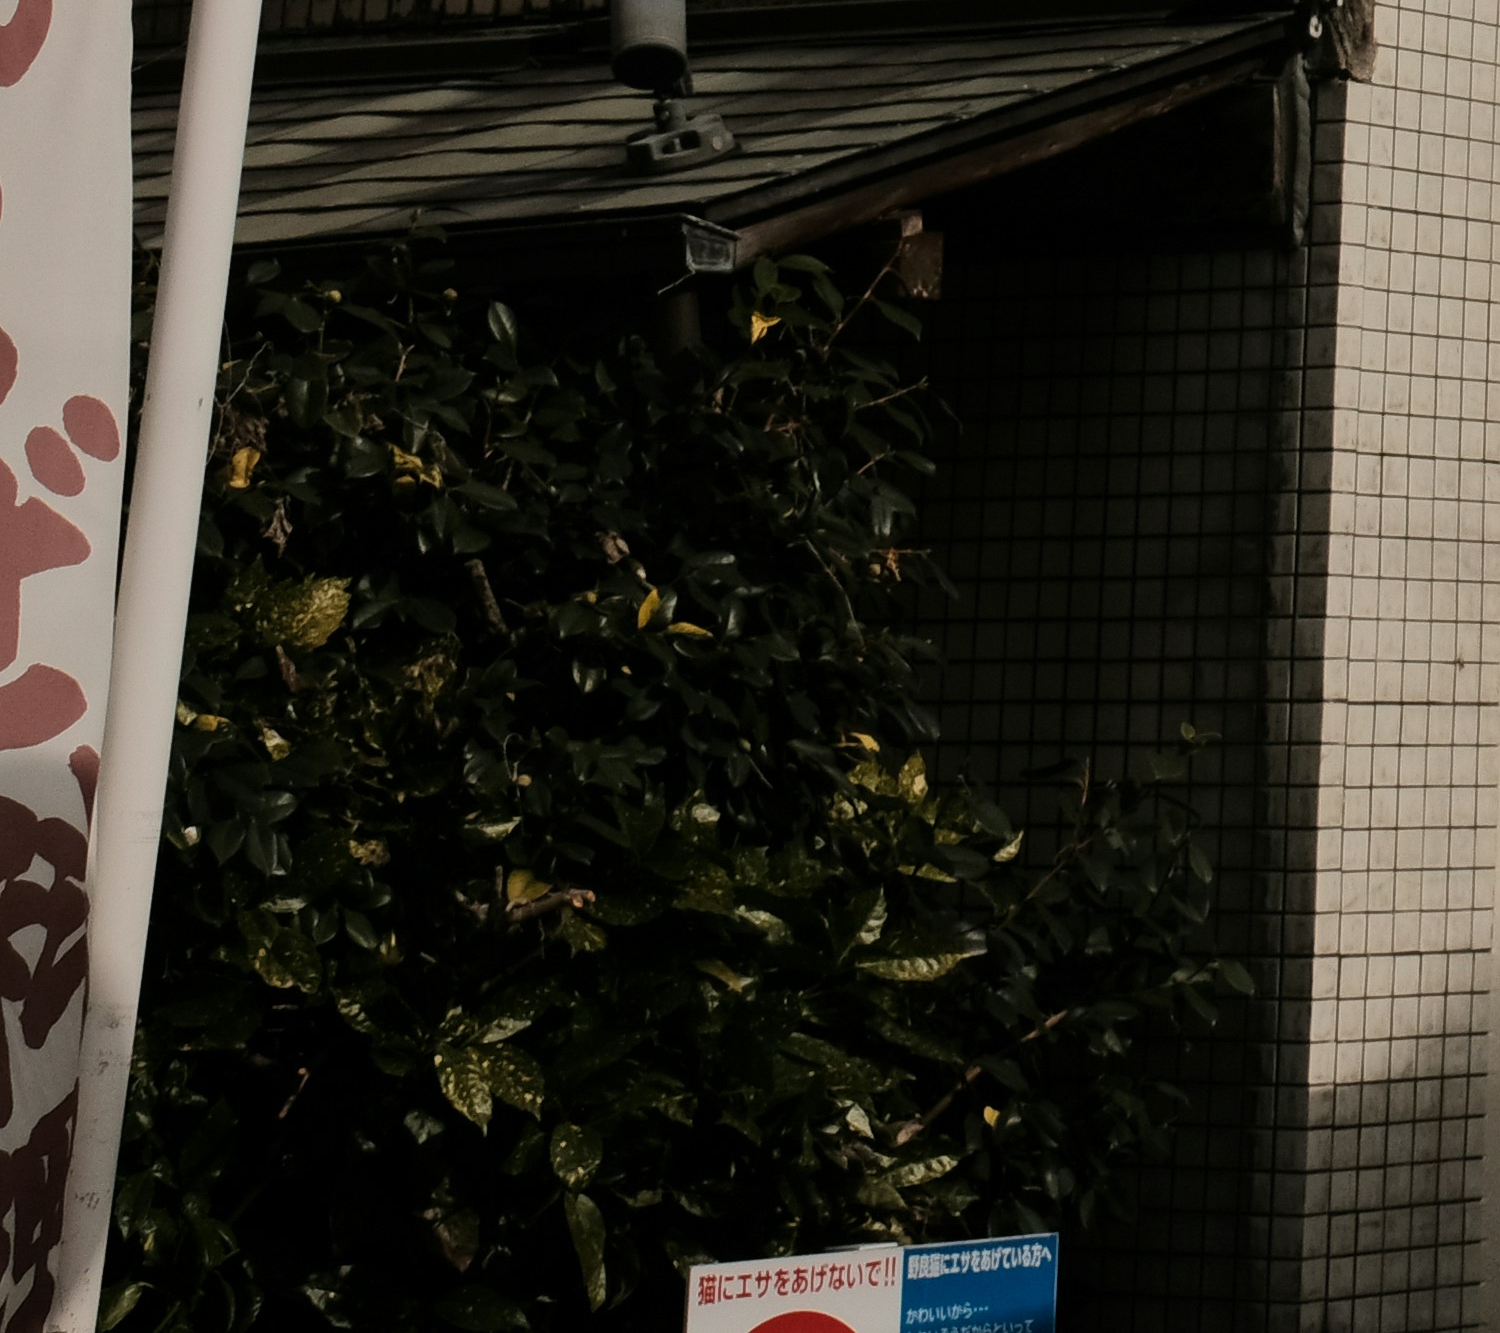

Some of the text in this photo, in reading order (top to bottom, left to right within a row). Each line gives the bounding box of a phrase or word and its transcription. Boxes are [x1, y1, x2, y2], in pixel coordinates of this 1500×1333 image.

[697, 1255, 898, 1307] 猫にエサをあげないで!!
